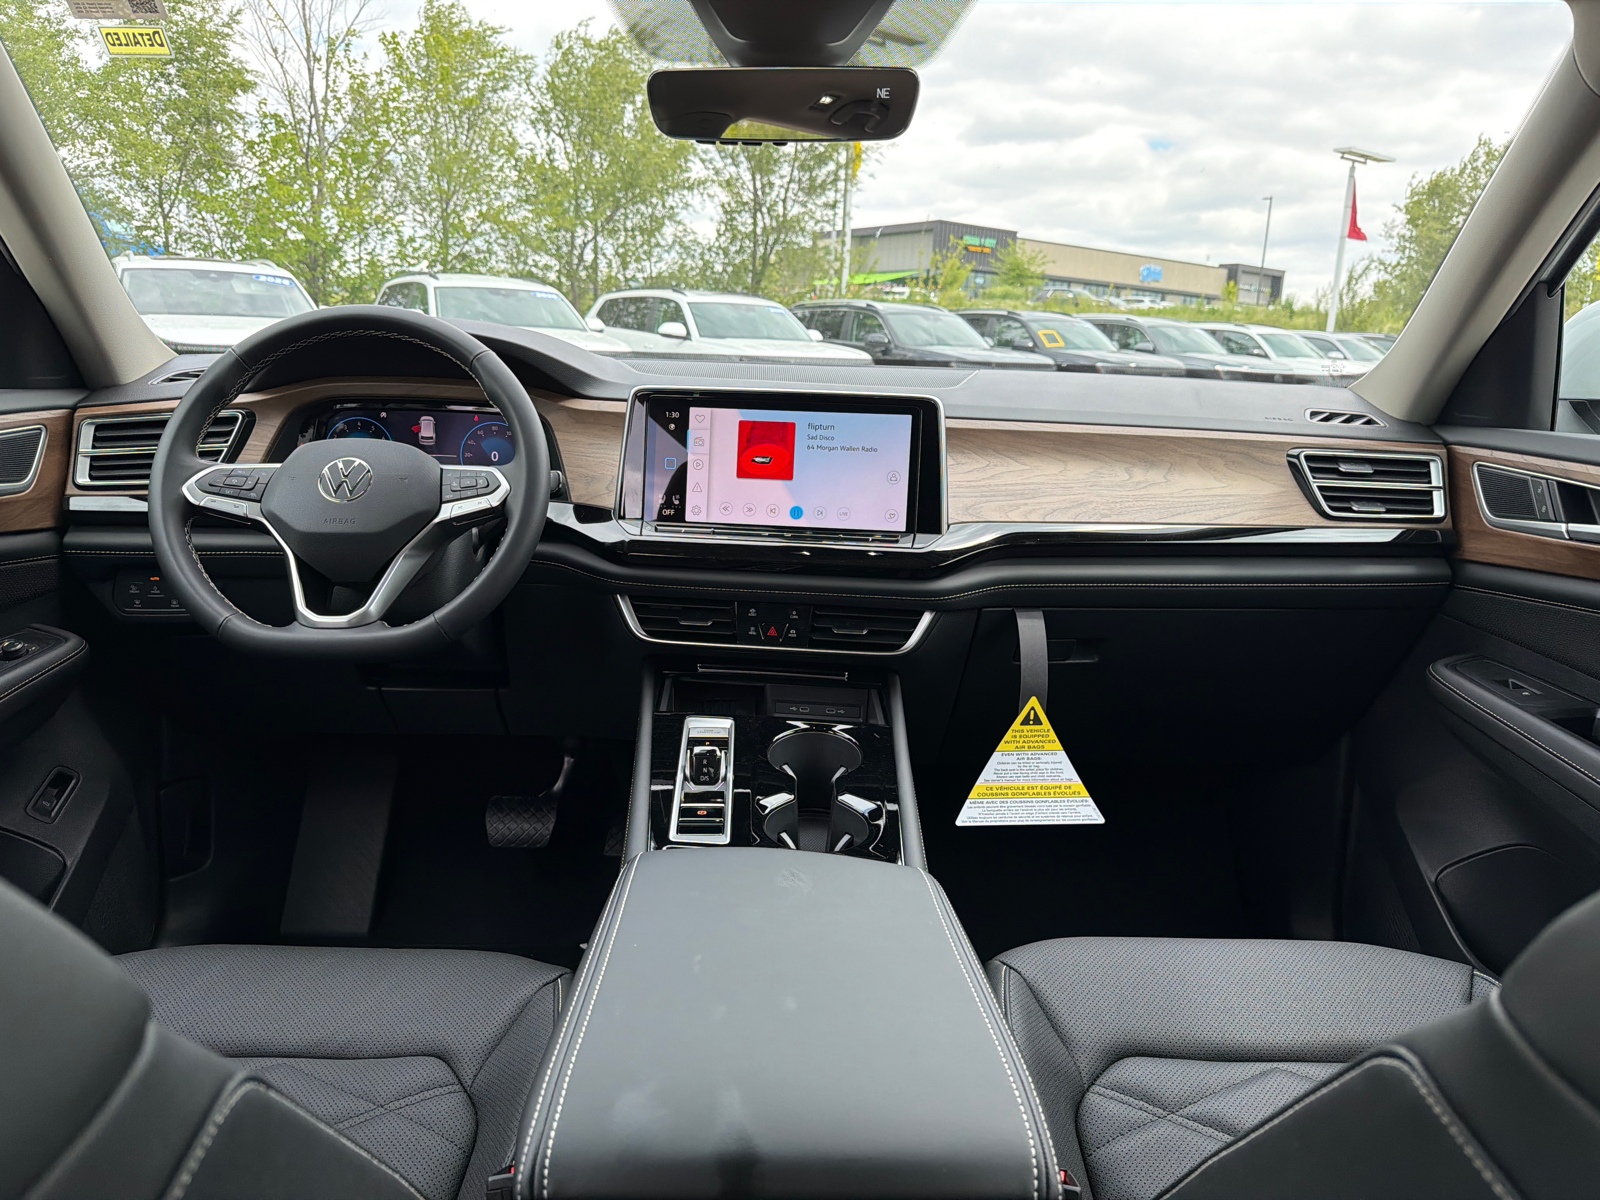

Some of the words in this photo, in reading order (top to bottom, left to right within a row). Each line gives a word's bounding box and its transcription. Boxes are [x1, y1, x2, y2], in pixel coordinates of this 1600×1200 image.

[876, 88, 890, 98] NE
[808, 422, 835, 432] flipturn
[491, 451, 499, 462] 0
